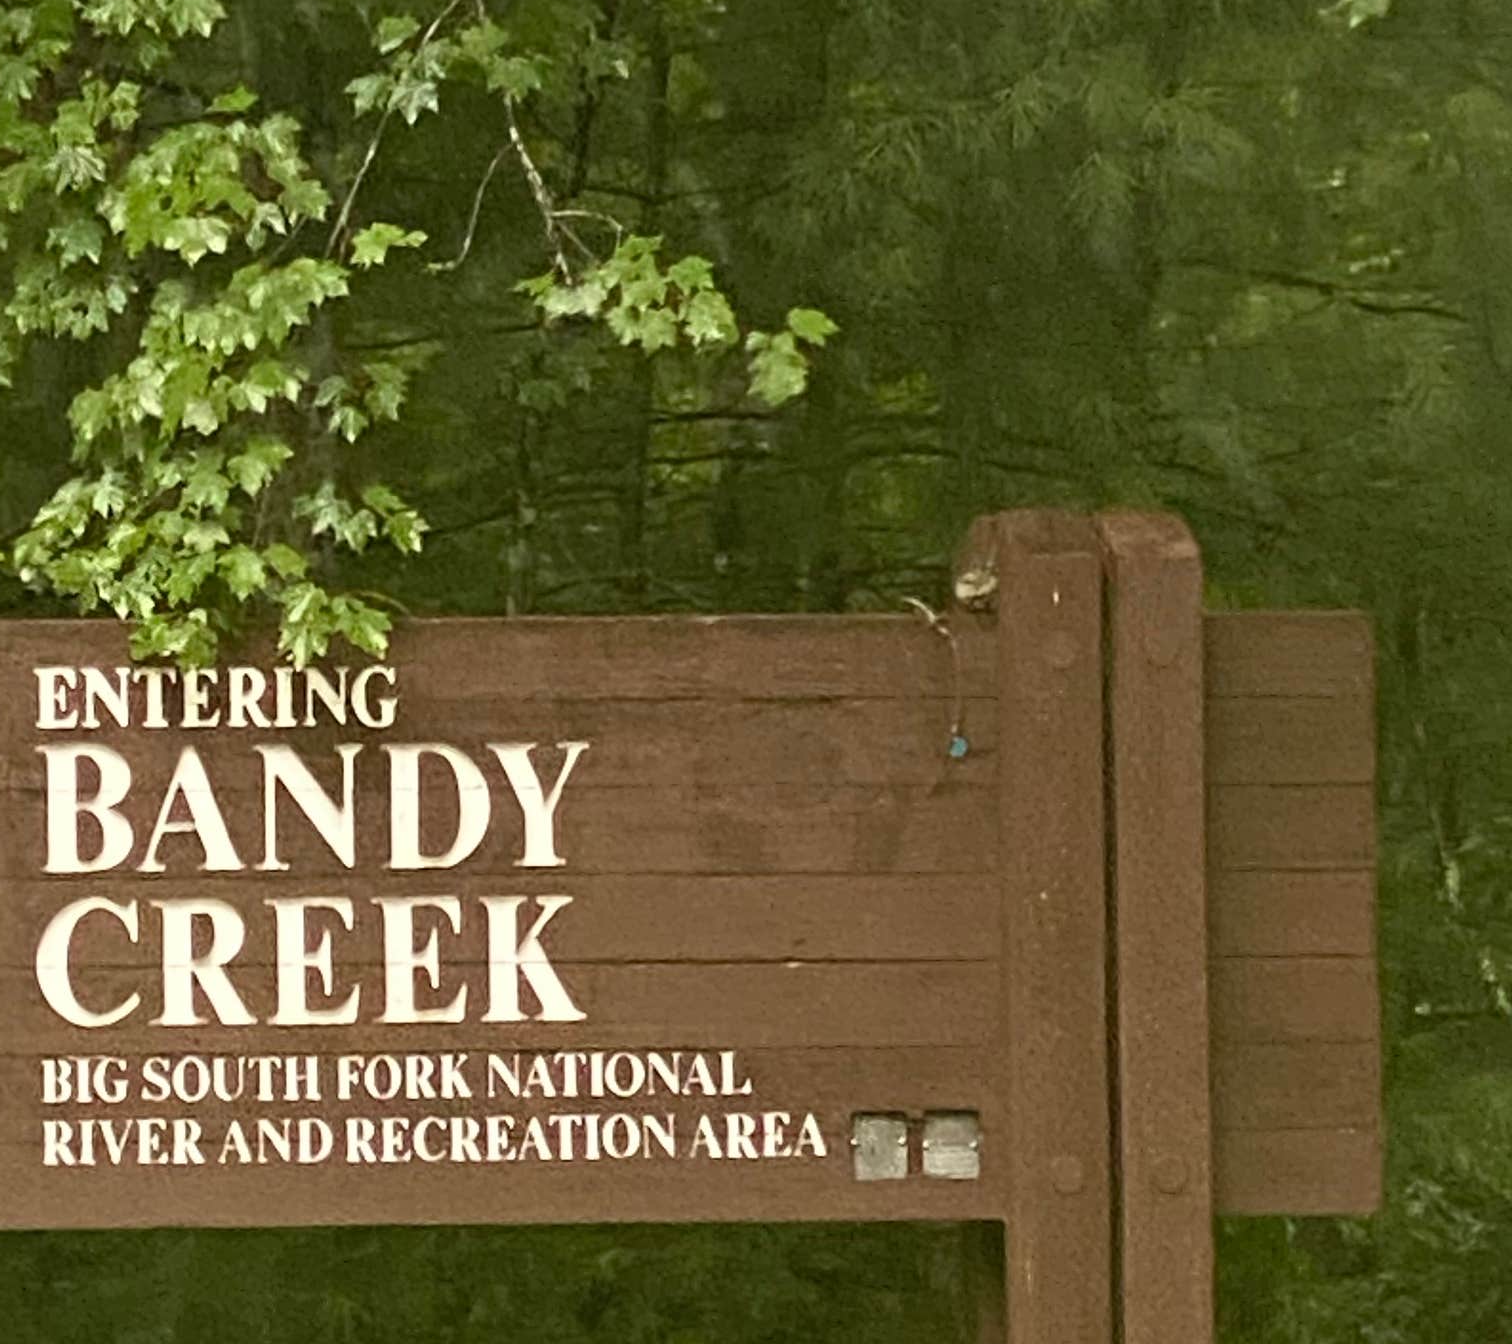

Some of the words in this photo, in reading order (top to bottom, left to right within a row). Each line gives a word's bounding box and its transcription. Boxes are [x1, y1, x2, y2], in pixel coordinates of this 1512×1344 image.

[32, 664, 399, 731] ENTERING
[35, 741, 591, 875] BANDY
[35, 894, 588, 1028] CREEK
[40, 1055, 130, 1105] BIG
[140, 1054, 323, 1104] SOUTH
[336, 1052, 474, 1101] FORK
[487, 1050, 754, 1099] NATIONAL
[42, 1117, 207, 1167] RIVER
[217, 1117, 335, 1165] AND
[344, 1112, 676, 1164] RECREATION
[692, 1110, 828, 1160] AREA
